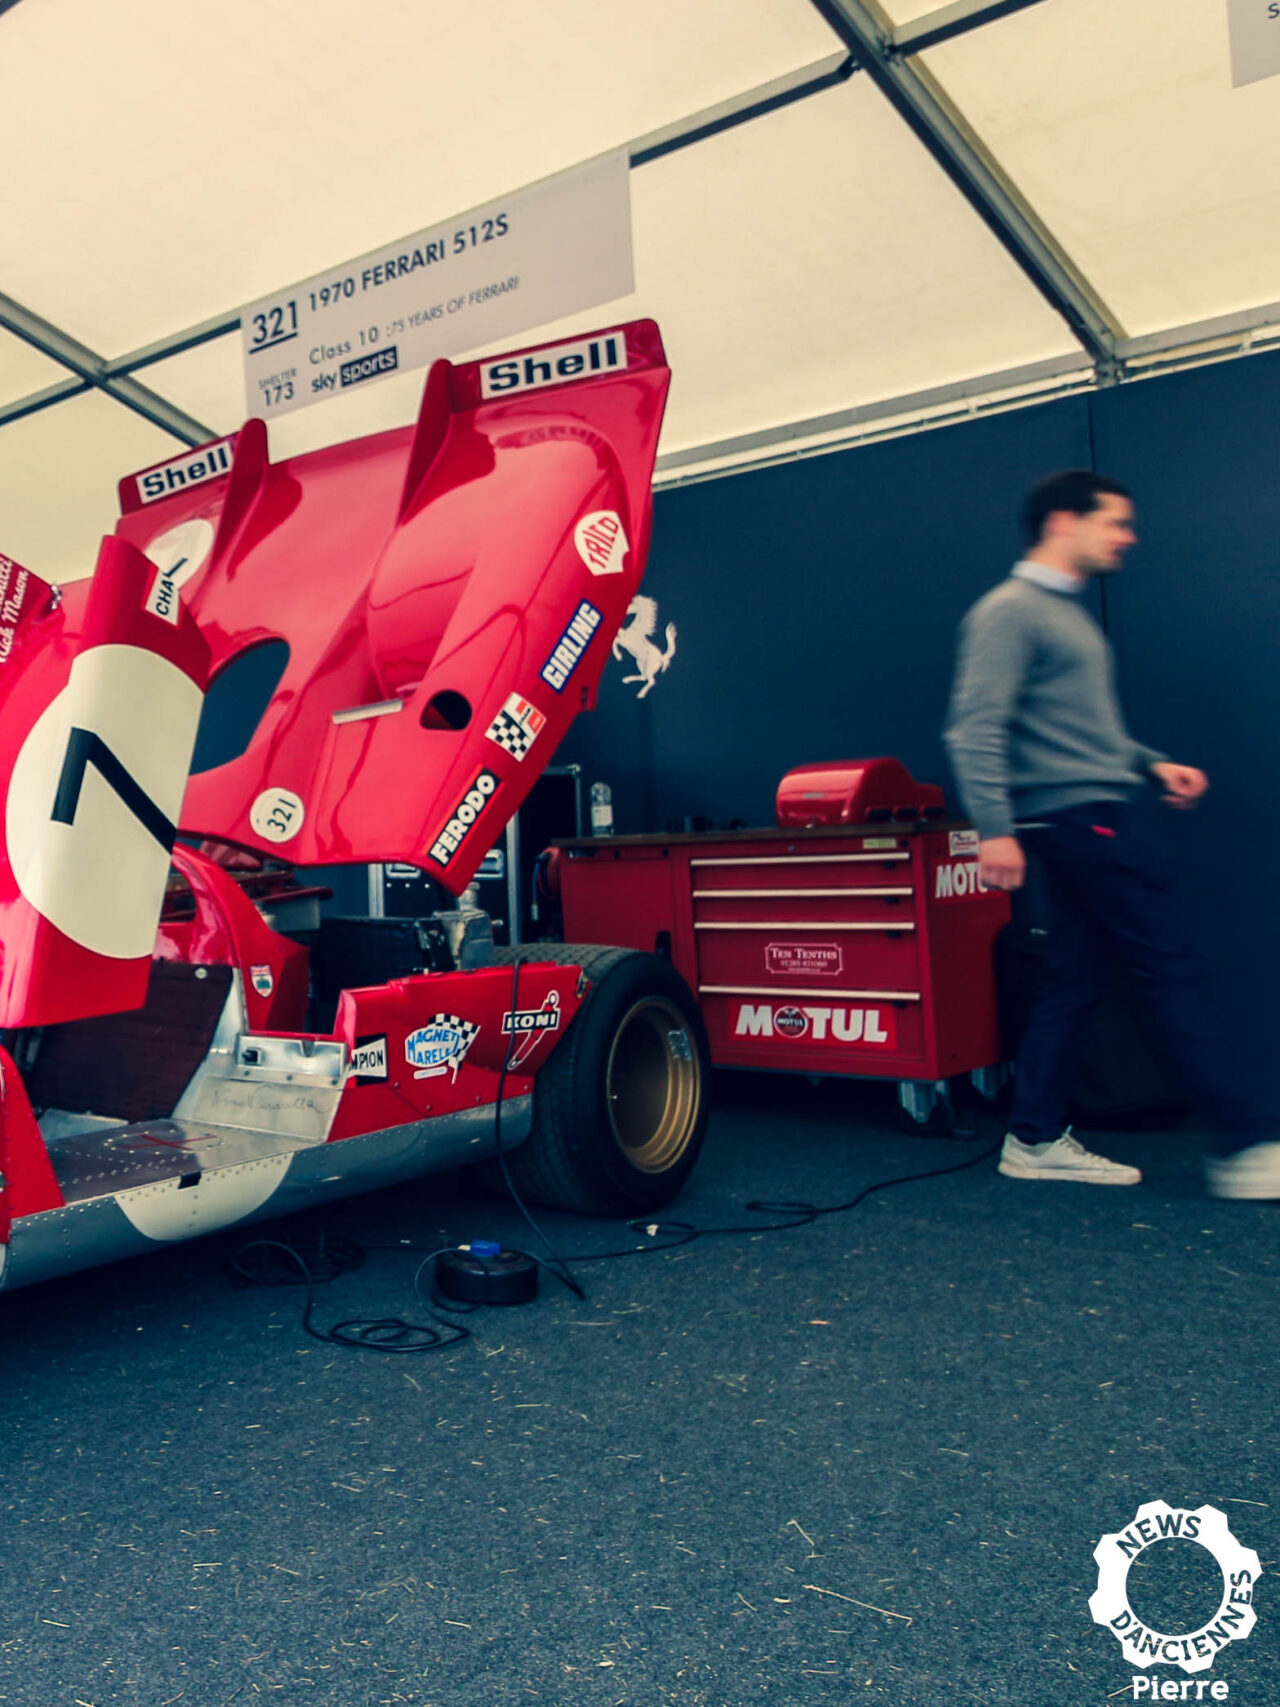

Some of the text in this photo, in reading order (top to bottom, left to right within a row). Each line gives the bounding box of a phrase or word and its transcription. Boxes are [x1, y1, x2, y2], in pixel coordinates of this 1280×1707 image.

[309, 214, 509, 311] 1970 FERRARI 512S
[251, 301, 298, 345] 321
[309, 340, 351, 365] Class
[358, 326, 379, 348] 10
[407, 304, 443, 327] YEARS
[446, 295, 466, 314] OF
[468, 275, 519, 306] FERRARI
[311, 351, 397, 393] sky sports
[488, 337, 618, 392] Shell
[264, 382, 295, 406] 173
[142, 447, 229, 498] Shell
[1, 570, 30, 624] Mason
[542, 602, 601, 690] GIRLING
[266, 798, 297, 834] 321
[430, 774, 496, 865] FERODO
[506, 1013, 557, 1029] KONI
[734, 1003, 889, 1043] MOTUL
